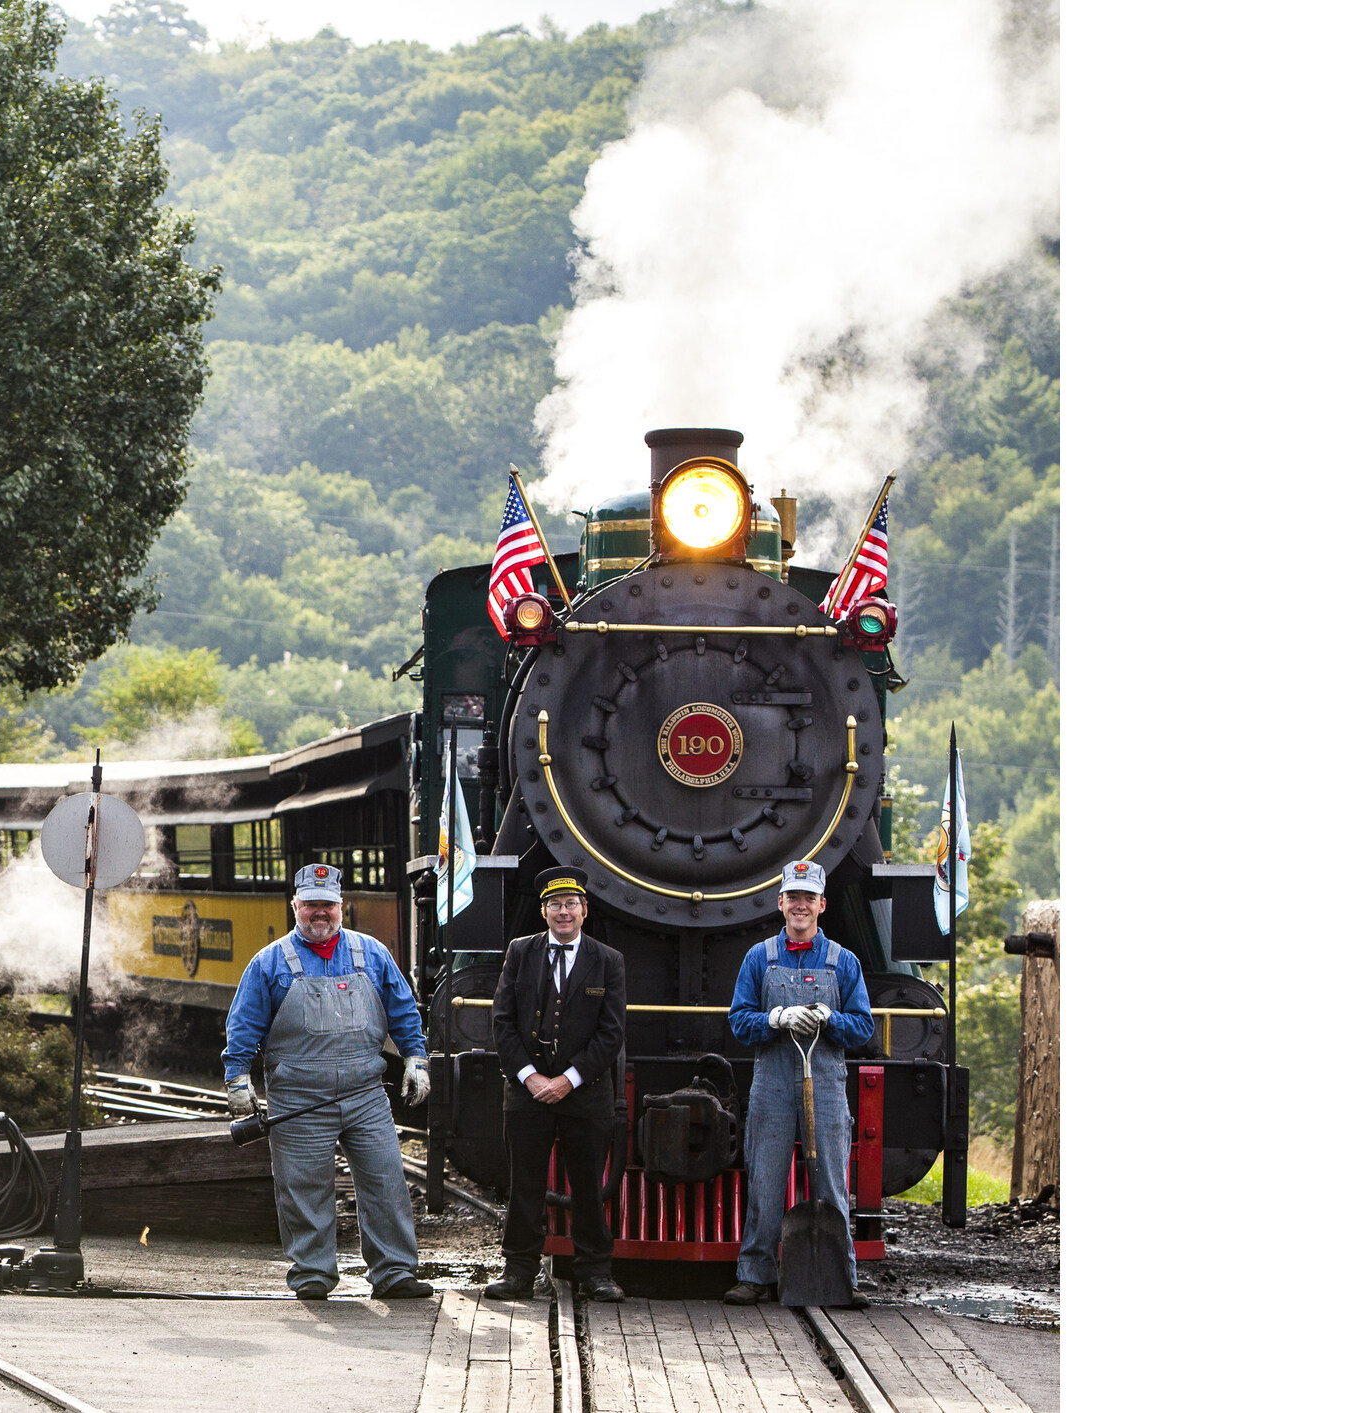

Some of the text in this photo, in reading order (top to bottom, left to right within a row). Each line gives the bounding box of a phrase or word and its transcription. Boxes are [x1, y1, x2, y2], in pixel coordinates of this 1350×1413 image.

[660, 705, 740, 755] THE BALDWIN LOCOMOTIVE WORKS
[677, 735, 725, 756] 190
